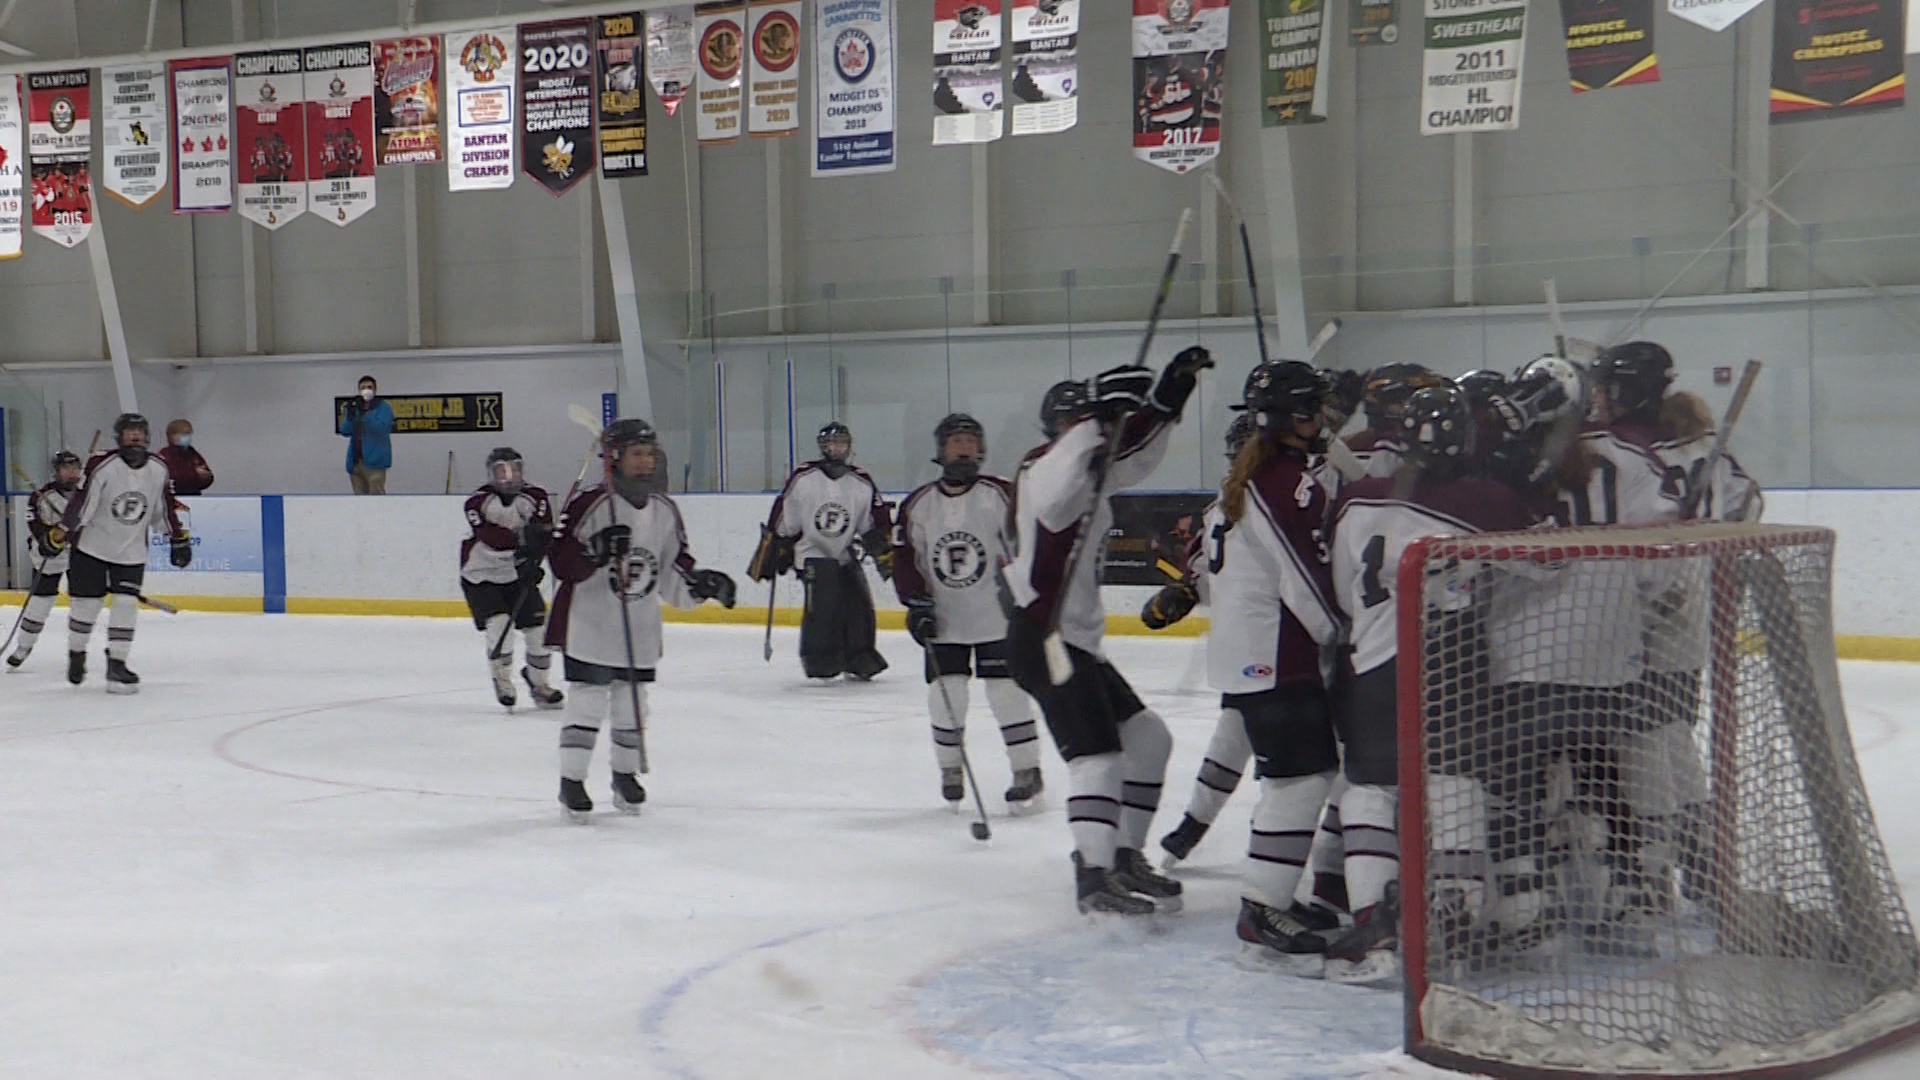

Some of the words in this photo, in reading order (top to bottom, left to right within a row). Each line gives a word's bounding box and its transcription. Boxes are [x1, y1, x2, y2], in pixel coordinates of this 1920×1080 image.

[1030, 38, 1070, 50] BANTAM
[237, 55, 300, 74] CHAMPIONS
[306, 47, 370, 69] CHAMPIONS
[524, 43, 588, 72] 2020
[951, 51, 991, 63] BANTAM
[1455, 49, 1504, 71] 2011
[31, 73, 87, 88] CHAMPIONS
[525, 86, 589, 101] INTERMEDIATE
[829, 90, 866, 103] MIDGET
[1467, 87, 1493, 104] HL
[556, 108, 589, 118] LEAGUE
[827, 103, 883, 118] CHAMPIONS
[526, 118, 589, 132] CHAMPIONS
[844, 119, 867, 130] 2018
[388, 137, 421, 150] ATOM
[464, 133, 508, 148] BANTAM
[1163, 127, 1202, 146] 2017
[462, 148, 510, 163] DIVISION
[464, 164, 509, 178] CHAMPS
[54, 211, 83, 226] 2015
[444, 397, 465, 418] JR
[476, 395, 500, 428] K
[122, 499, 138, 516] F
[825, 511, 840, 529] F
[946, 545, 968, 575] F
[1361, 535, 1390, 608] 1
